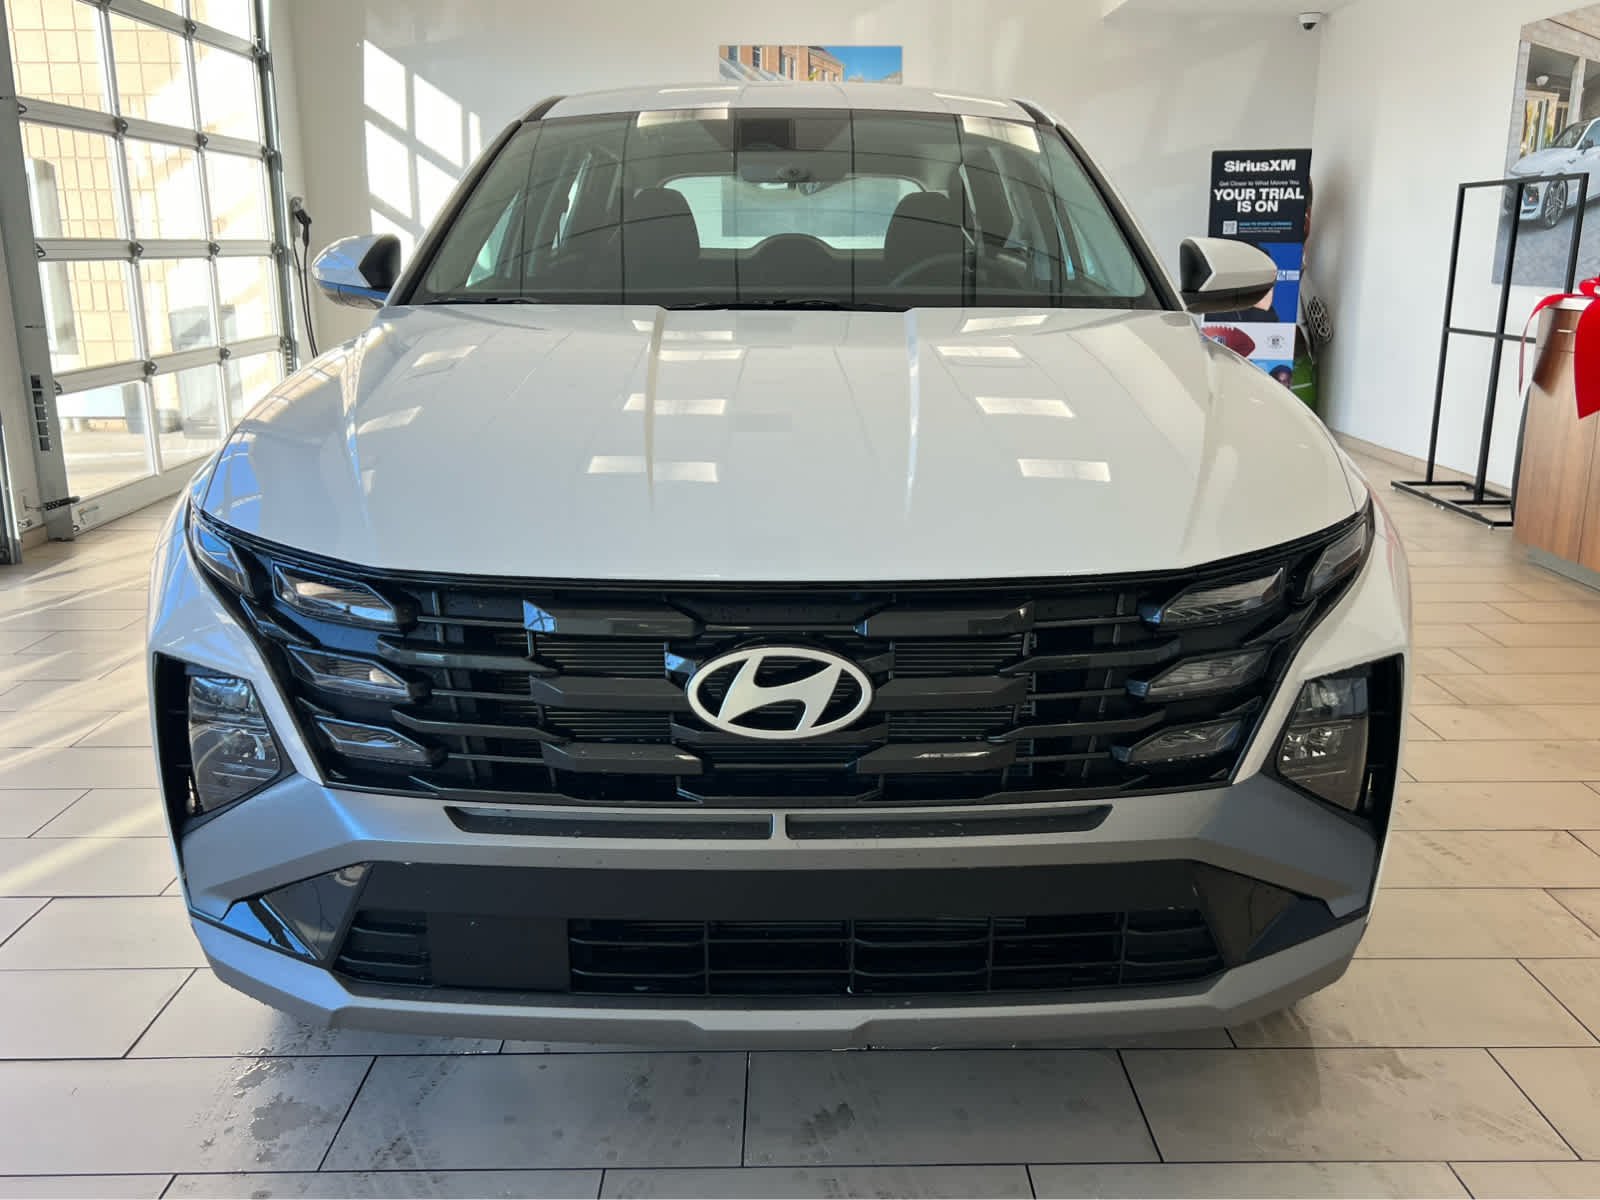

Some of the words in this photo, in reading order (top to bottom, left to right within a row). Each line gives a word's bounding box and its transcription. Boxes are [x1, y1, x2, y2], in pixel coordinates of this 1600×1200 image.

[1224, 159, 1296, 172] SiriusXM
[1214, 188, 1256, 201] YOUR
[1259, 187, 1304, 200] TRIAL
[1237, 201, 1252, 213] IS
[1255, 200, 1279, 212] ON
